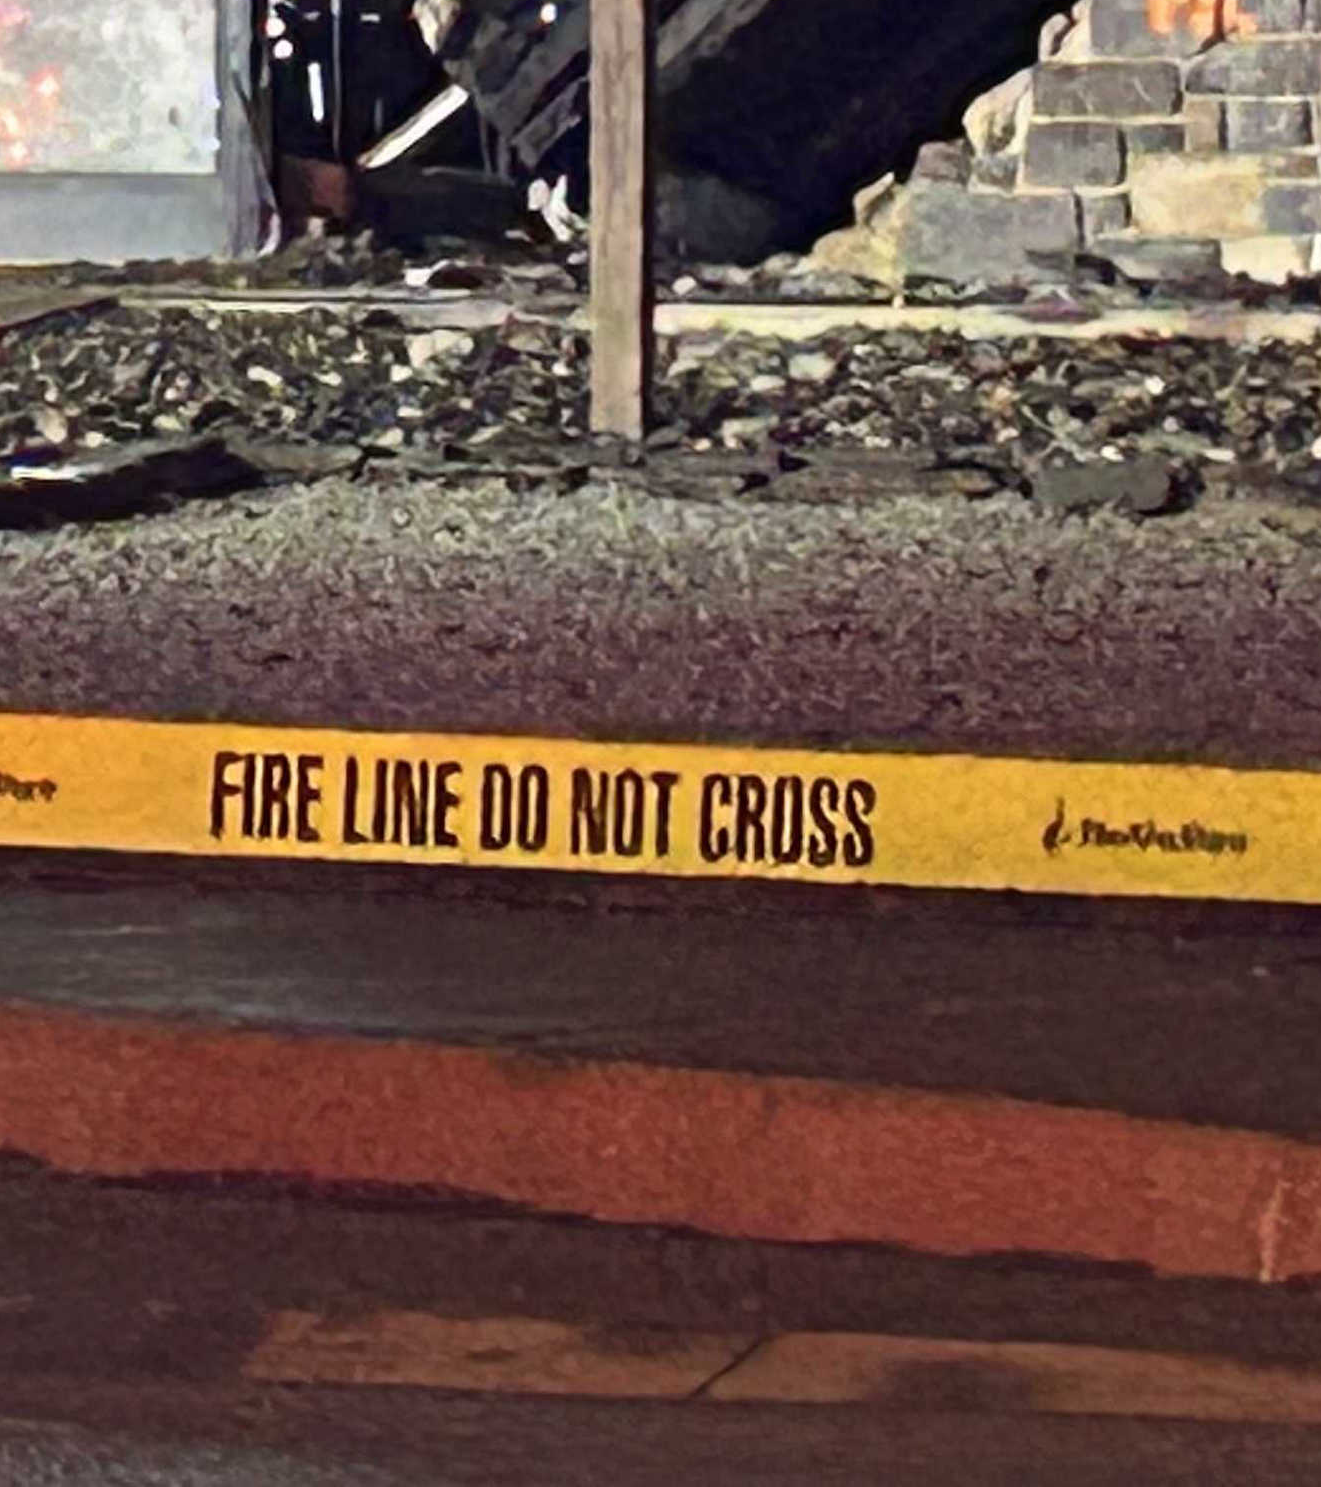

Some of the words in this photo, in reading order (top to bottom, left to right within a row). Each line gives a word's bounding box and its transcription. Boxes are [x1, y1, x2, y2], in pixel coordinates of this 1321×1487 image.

[210, 751, 324, 843] FIRE
[342, 756, 463, 848] LINE
[479, 763, 550, 853] DO
[570, 767, 681, 858] NOT
[698, 772, 876, 868] CROSS
